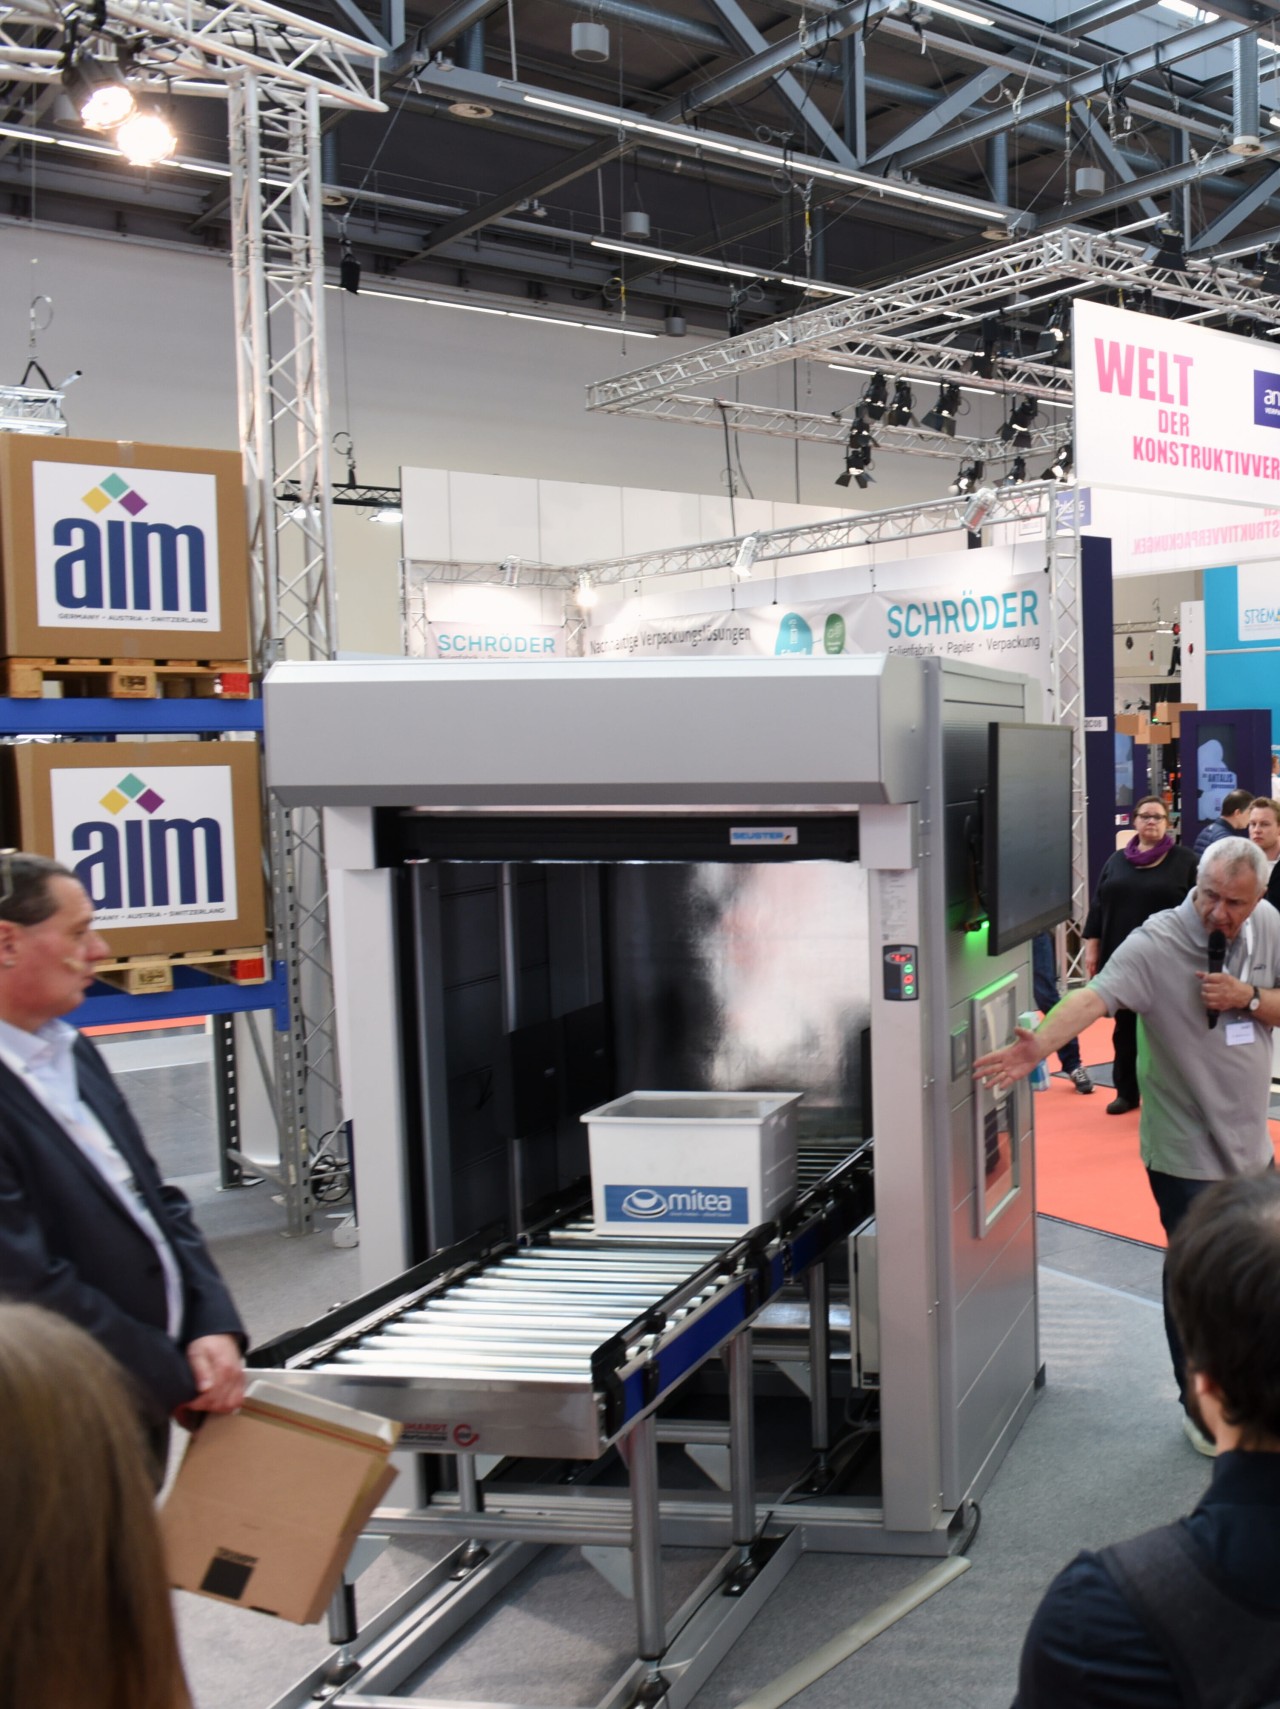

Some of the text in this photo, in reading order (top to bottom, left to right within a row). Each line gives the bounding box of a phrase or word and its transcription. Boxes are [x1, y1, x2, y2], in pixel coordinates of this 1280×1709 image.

[1094, 337, 1194, 407] WELT
[1158, 410, 1190, 437] DER
[53, 518, 208, 612] aim
[58, 613, 100, 621] GERMANY
[151, 616, 208, 624] SWITZERLAND
[887, 589, 1039, 639] SCHRÖDER
[437, 633, 556, 653] SCHRÖDER
[640, 624, 751, 648] Verpackungslösungen
[947, 641, 975, 656] Papier
[986, 636, 1041, 651] Verpackung
[72, 817, 225, 911] aim
[169, 907, 226, 917] SWITZERLAND
[668, 1189, 732, 1212] mitea
